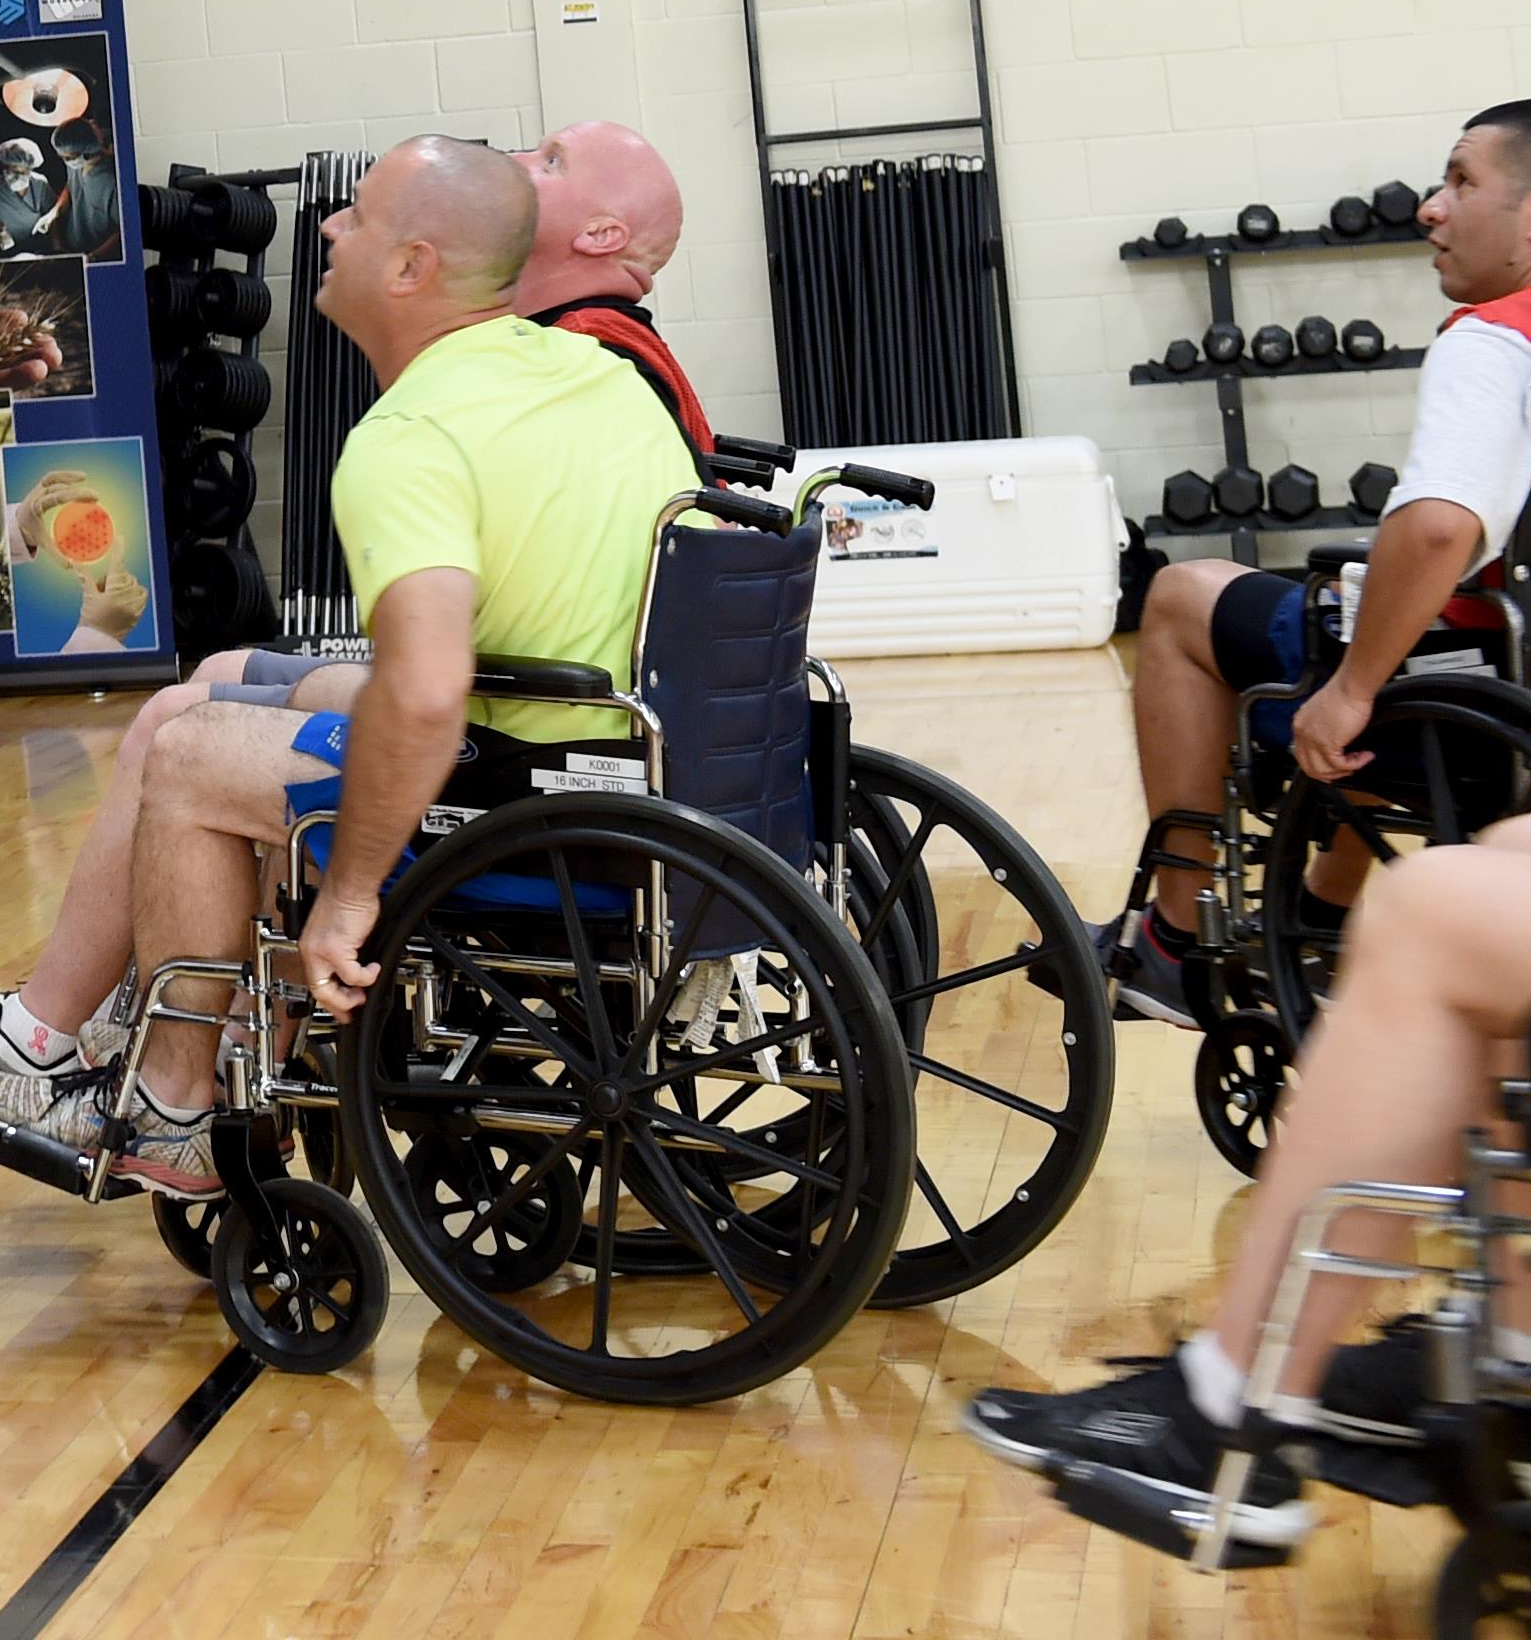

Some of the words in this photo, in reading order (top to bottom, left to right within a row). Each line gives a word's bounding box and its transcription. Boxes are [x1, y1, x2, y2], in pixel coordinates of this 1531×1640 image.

[319, 637, 375, 652] POWE
[554, 775, 566, 786] 16
[569, 776, 597, 789] INCH
[601, 779, 625, 793] STD
